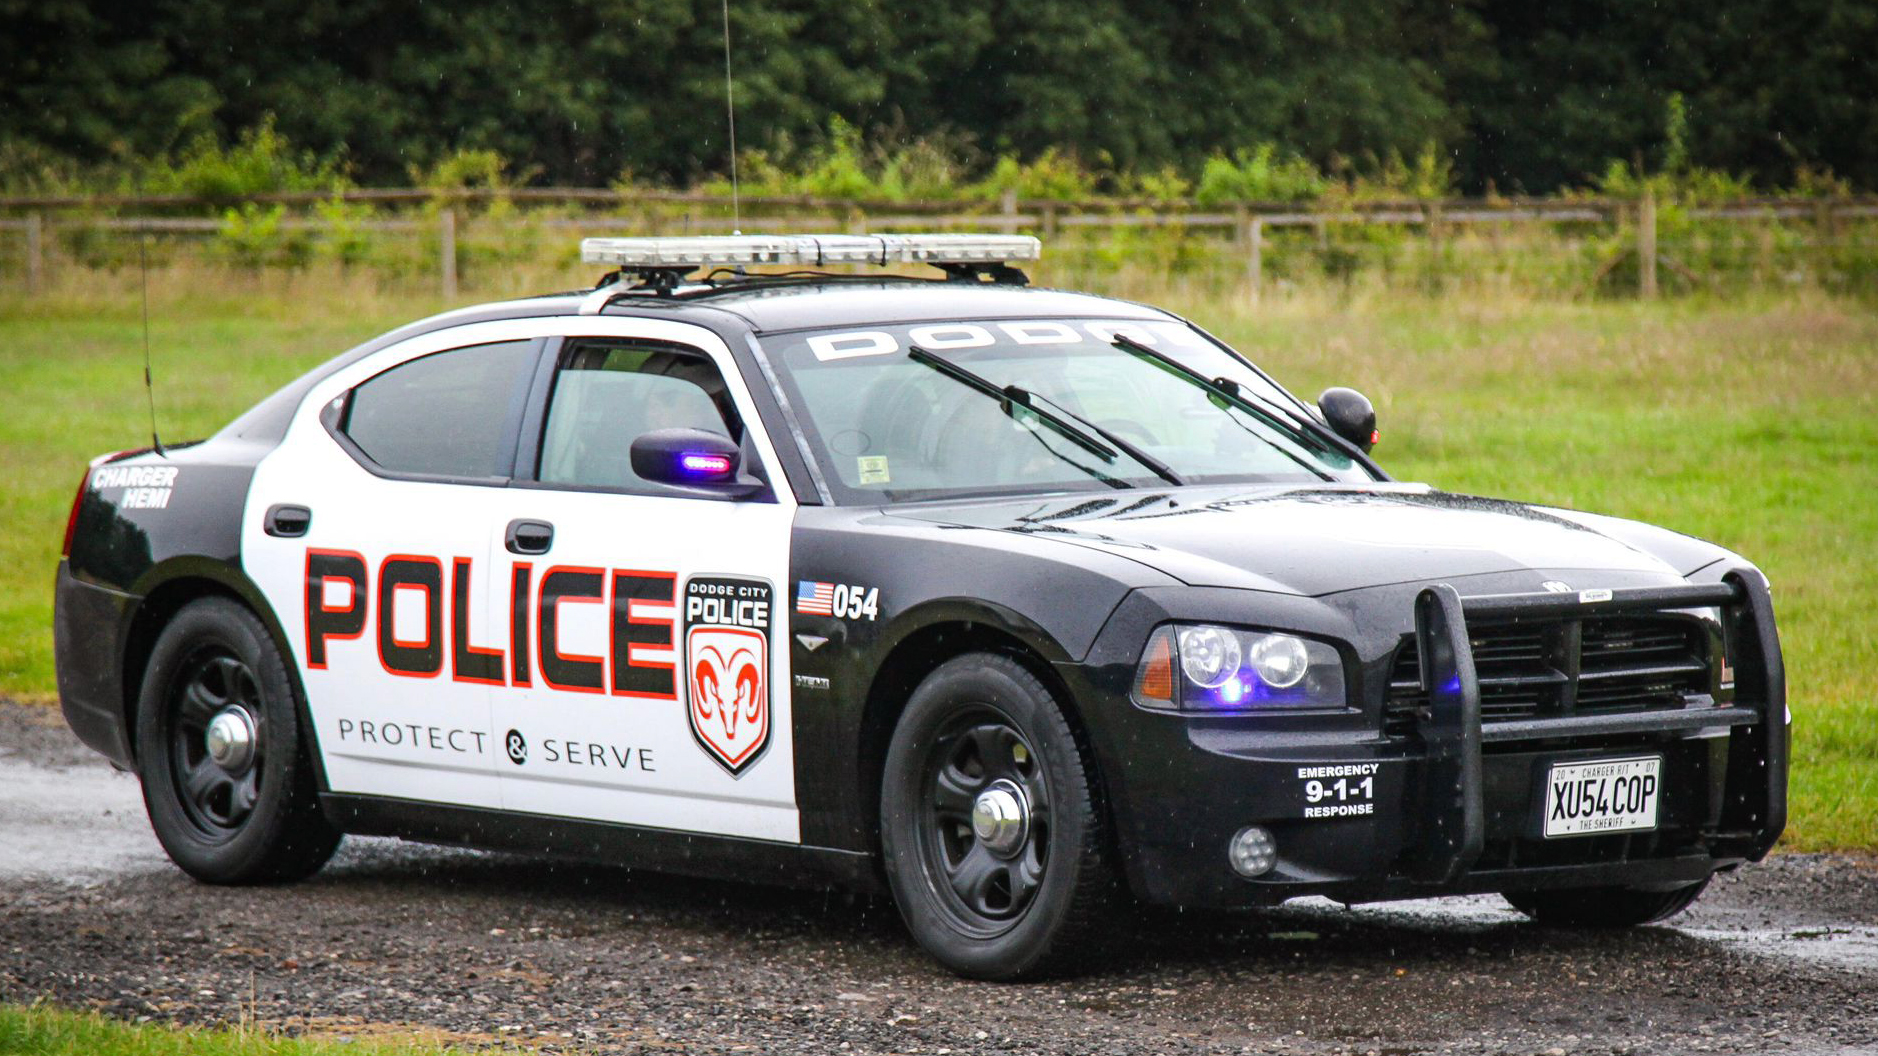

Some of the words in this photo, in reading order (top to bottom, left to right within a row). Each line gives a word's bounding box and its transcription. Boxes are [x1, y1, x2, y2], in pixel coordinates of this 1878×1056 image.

[94, 466, 179, 488] CHARGER
[121, 487, 172, 509] HEMI
[689, 582, 734, 596] DODGE
[738, 587, 768, 598] CITY
[687, 596, 769, 627] POLICE
[832, 583, 879, 621] 054
[304, 547, 678, 701] POLICE
[338, 718, 487, 754] PROTECT
[543, 738, 657, 772] SERVE
[1298, 763, 1379, 778] EMERGENCY
[1582, 765, 1615, 778] CHARGER
[1617, 764, 1630, 774] R/T
[1305, 776, 1373, 803] 9-1-1
[1304, 803, 1374, 818] RESPONSE
[1580, 819, 1592, 830] THE
[1594, 817, 1624, 829] SHERIFF
